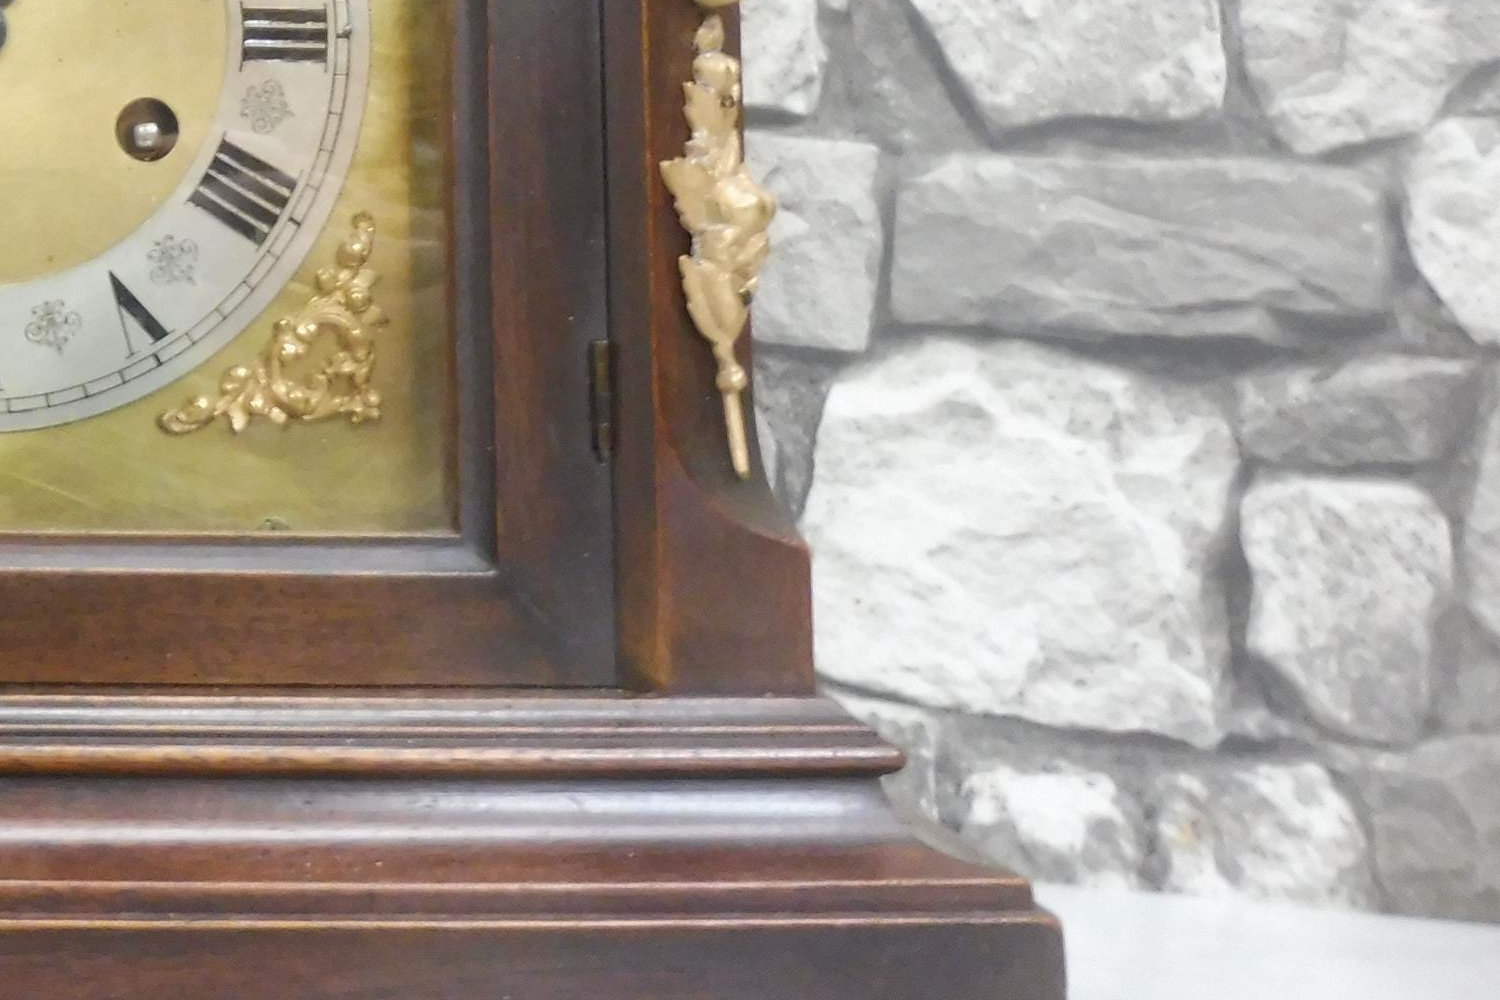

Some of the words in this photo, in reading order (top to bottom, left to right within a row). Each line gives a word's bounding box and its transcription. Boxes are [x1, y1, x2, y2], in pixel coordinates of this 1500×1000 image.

[239, 0, 328, 73] III
[185, 130, 304, 253] IIII
[108, 270, 175, 360] V
